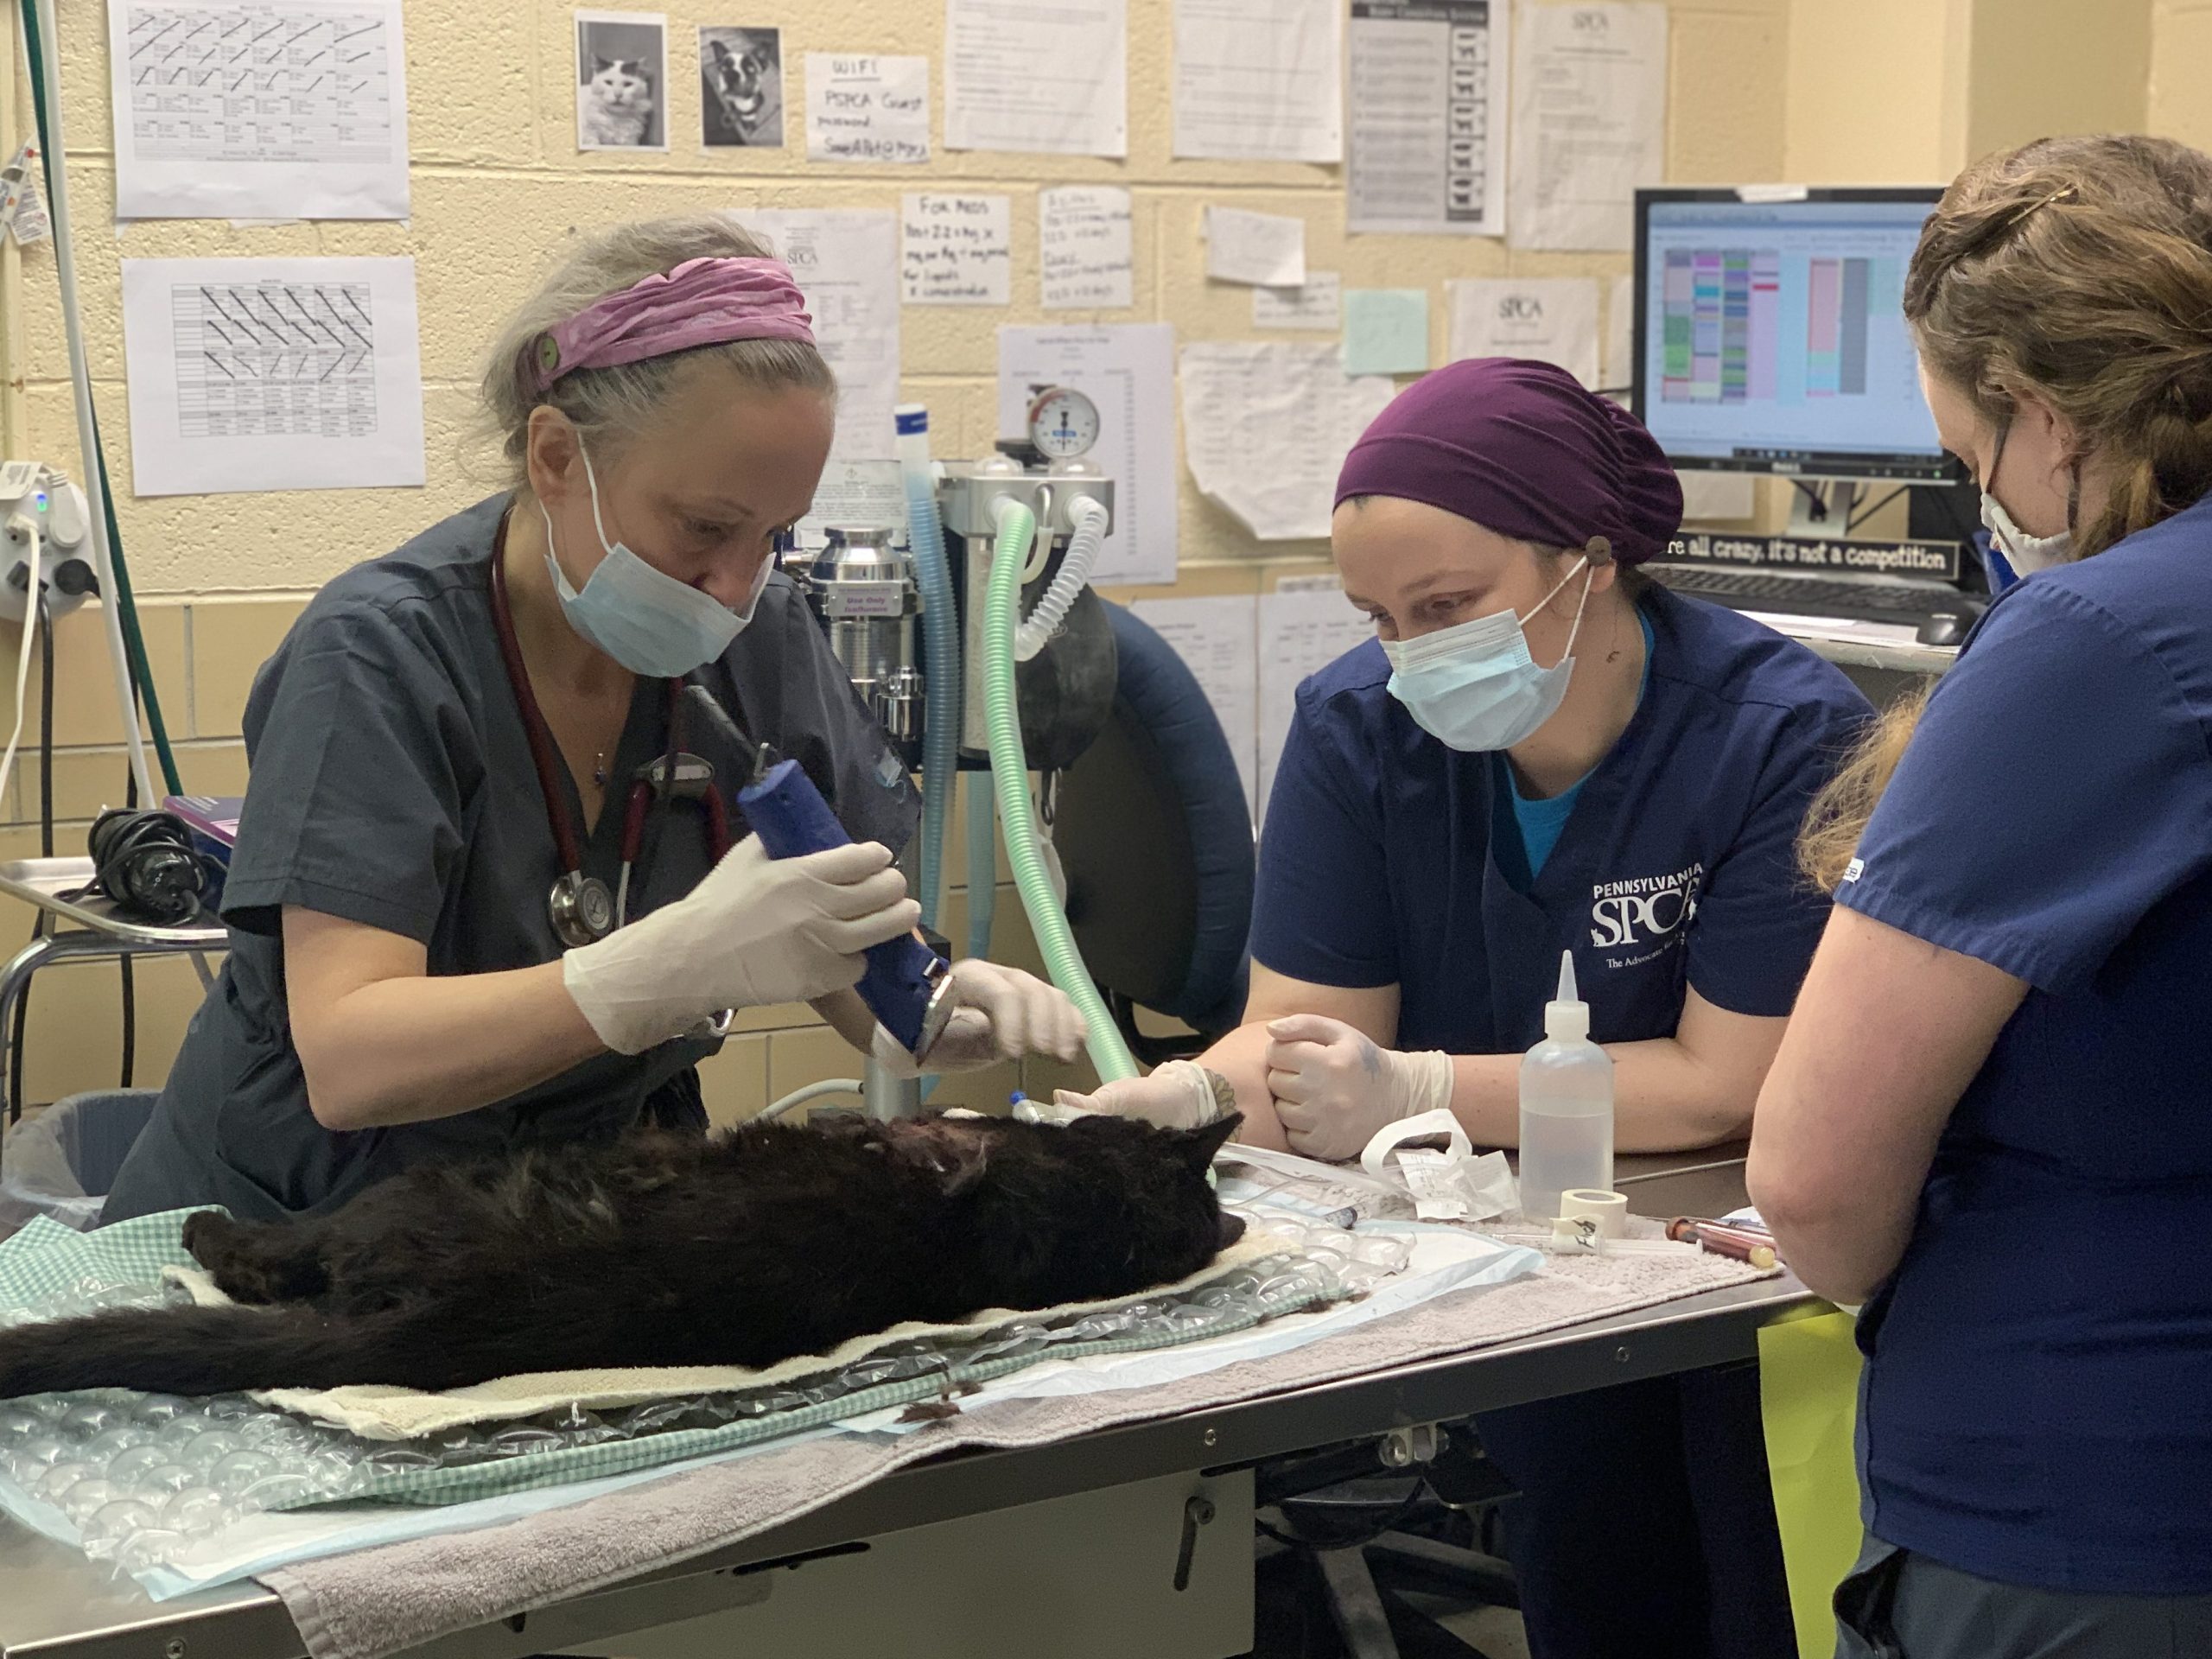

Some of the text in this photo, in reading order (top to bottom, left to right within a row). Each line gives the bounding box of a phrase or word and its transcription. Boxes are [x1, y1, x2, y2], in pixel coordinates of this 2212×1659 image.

[1688, 535, 1710, 557] all
[1799, 542, 1827, 563] not
[1830, 546, 1842, 562] a
[1845, 544, 1947, 571] competition
[1592, 862, 1704, 899] PENNSYLVANIA
[1605, 957, 1624, 969] The
